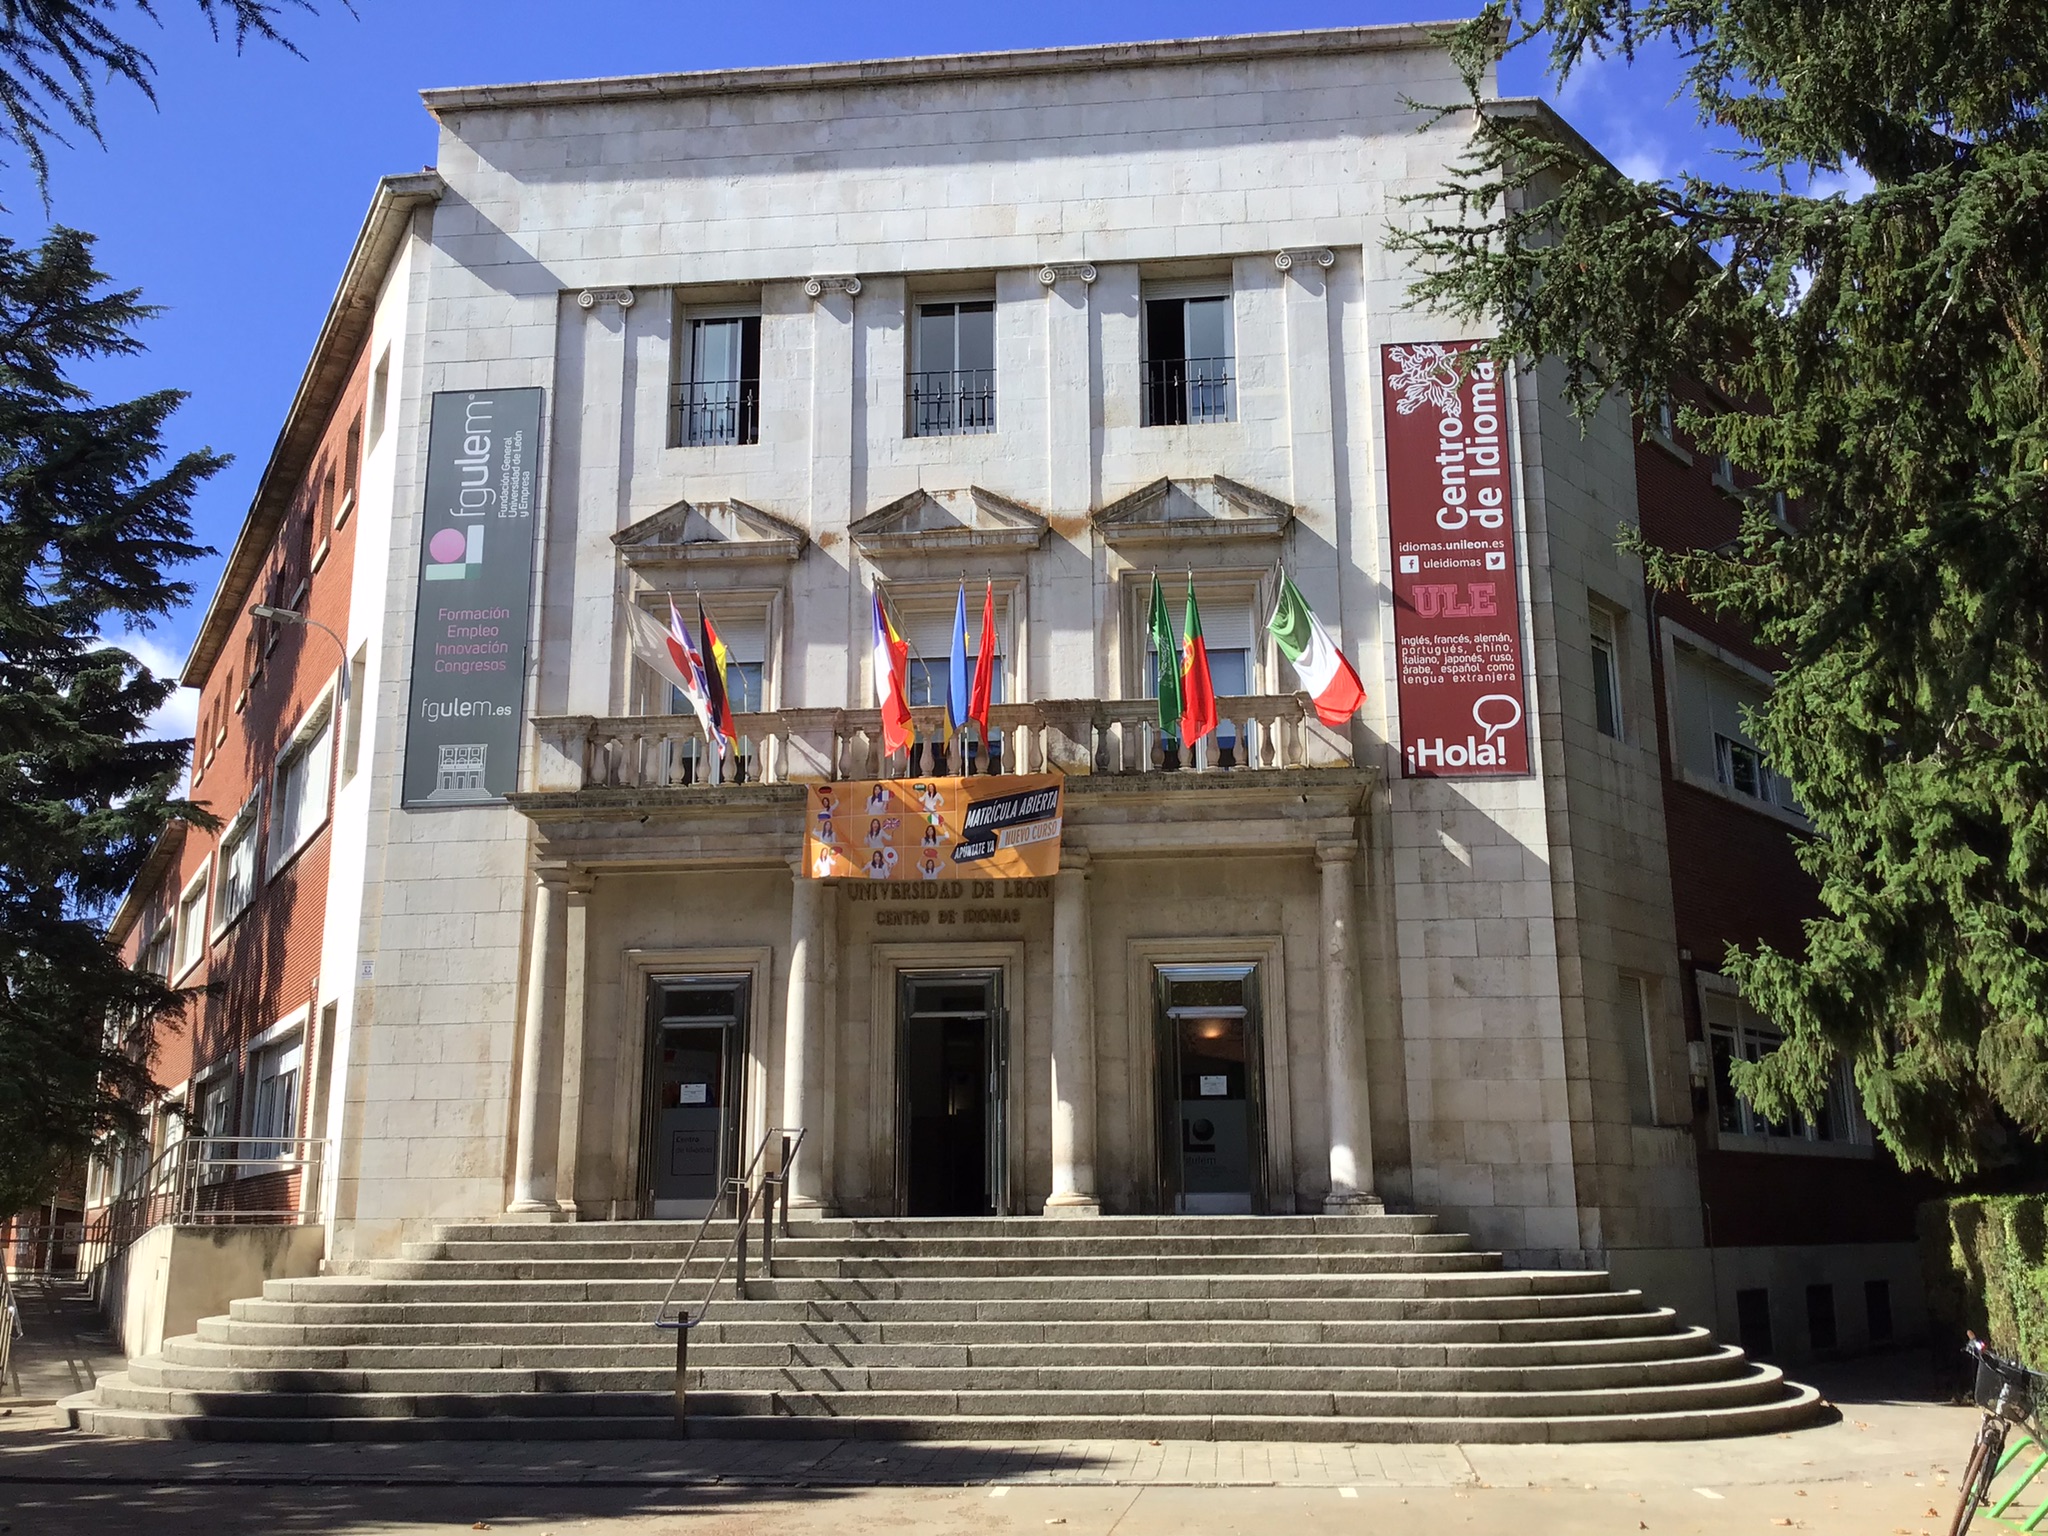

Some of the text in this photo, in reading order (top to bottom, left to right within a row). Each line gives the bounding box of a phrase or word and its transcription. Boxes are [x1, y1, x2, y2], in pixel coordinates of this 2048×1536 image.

[449, 401, 496, 516] fgulem
[498, 437, 512, 518] Fundación General
[508, 430, 523, 518] Universidad de León
[1435, 417, 1469, 531] Centro
[519, 471, 530, 509] Empresa
[1469, 487, 1504, 529] de
[1399, 540, 1505, 552] idiomas.unileon.es
[1423, 558, 1481, 569] uleidiomas
[1412, 583, 1497, 618] ULE
[438, 607, 510, 621] Formación
[447, 624, 499, 639] Empleo
[1401, 632, 1513, 647] inglés, francés, alemán,
[435, 641, 508, 655] Innovación
[1402, 643, 1514, 658] portugués, chino,
[434, 660, 506, 674] Congresos
[1402, 653, 1514, 665] italiano, japonés, ruso,
[1402, 663, 1515, 675] árabe, español como
[1403, 672, 1516, 686] lengua extranjera
[421, 697, 512, 723] fgulem.es
[1406, 735, 1507, 774] ¡Hola!
[964, 790, 1058, 829] MATRÍCULA ABIERTA
[1004, 821, 1058, 846] NUEVO CURSO
[986, 840, 995, 854] YA
[847, 880, 963, 901] UNIVERSIDAD
[972, 880, 994, 899] DE
[876, 907, 1021, 926] CENTRO DE IDIOMAS
